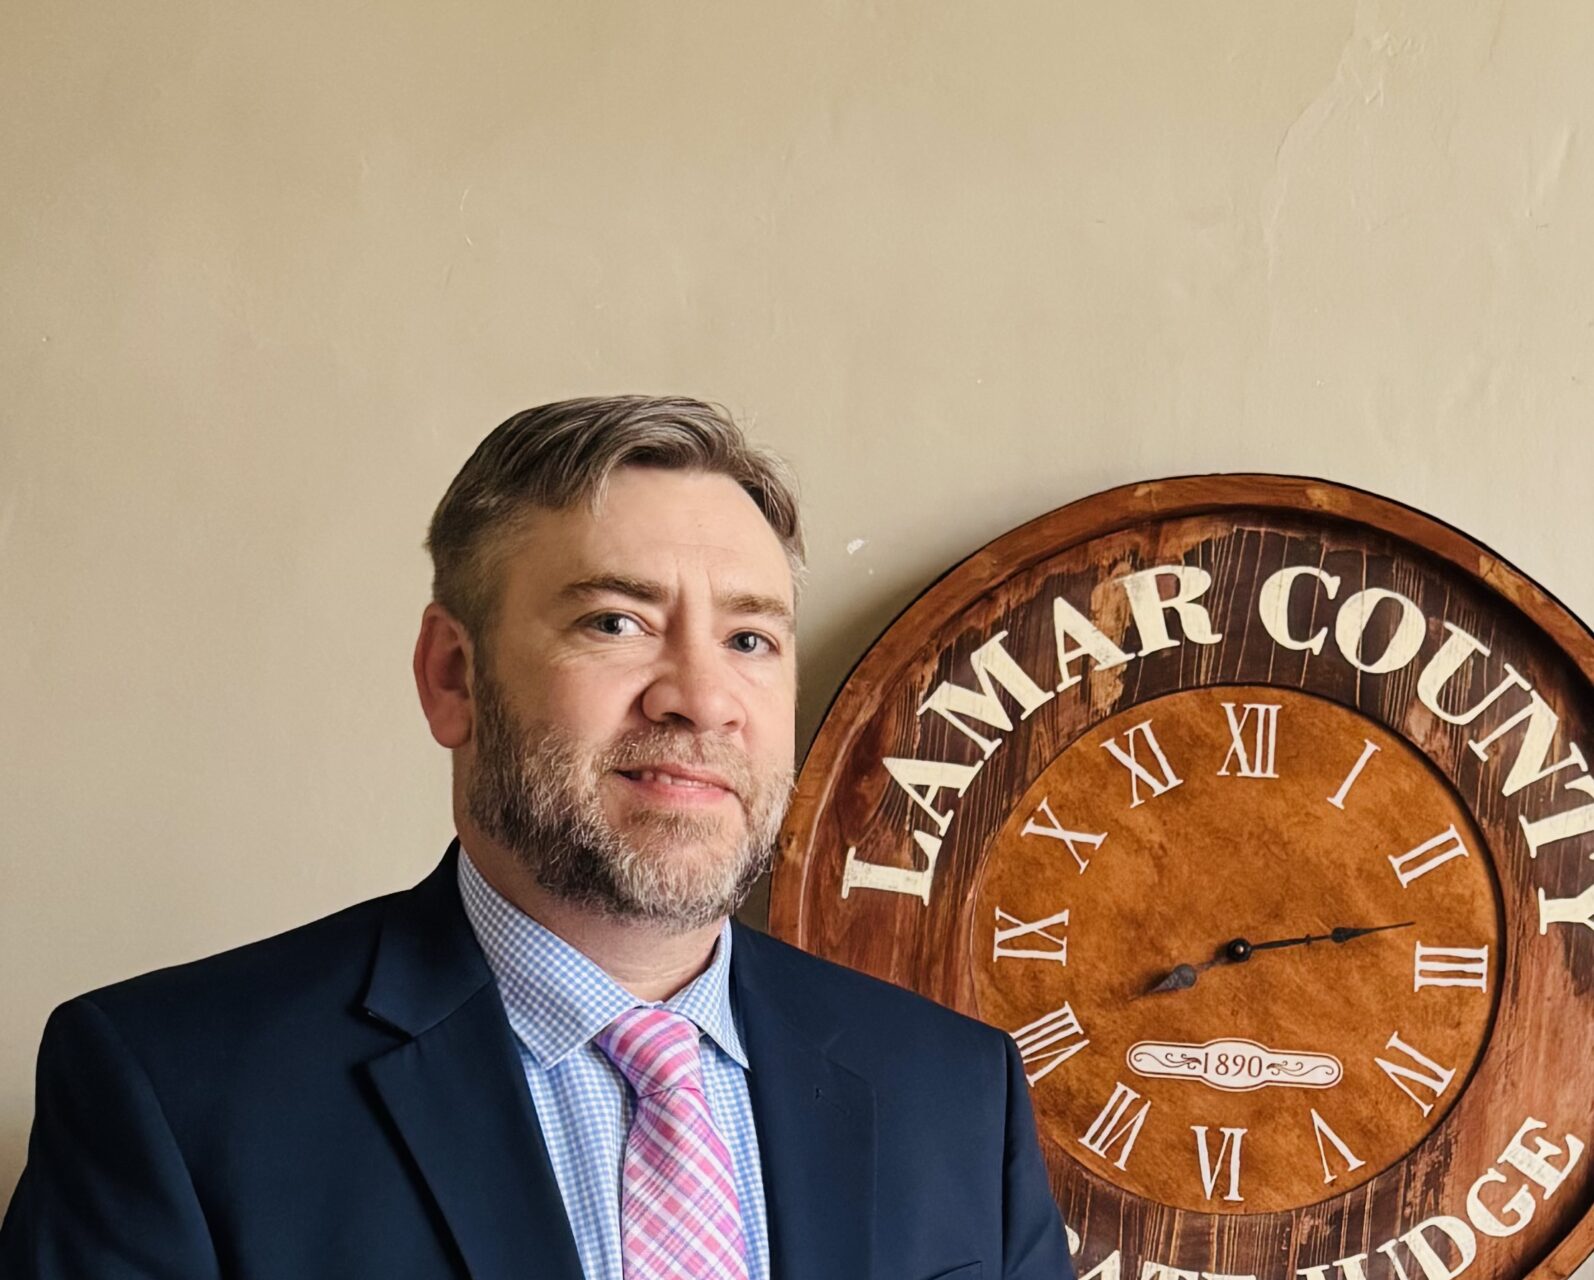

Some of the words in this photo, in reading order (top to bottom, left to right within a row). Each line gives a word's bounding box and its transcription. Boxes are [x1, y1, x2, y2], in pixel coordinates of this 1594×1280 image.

[842, 564, 1222, 905] LAMAR
[1259, 565, 1594, 936] COUNTY
[1101, 719, 1184, 808] XI
[1217, 702, 1282, 778] XII
[1328, 739, 1381, 810] I
[1022, 798, 1107, 873] X
[1388, 824, 1469, 888] II
[993, 906, 1070, 966] IX
[1414, 940, 1489, 993] III
[1202, 1051, 1262, 1078] 1890
[1374, 1032, 1456, 1117] IV
[1078, 1081, 1151, 1171] VII
[1191, 1126, 1247, 1202] VI
[1311, 1108, 1366, 1184] V
